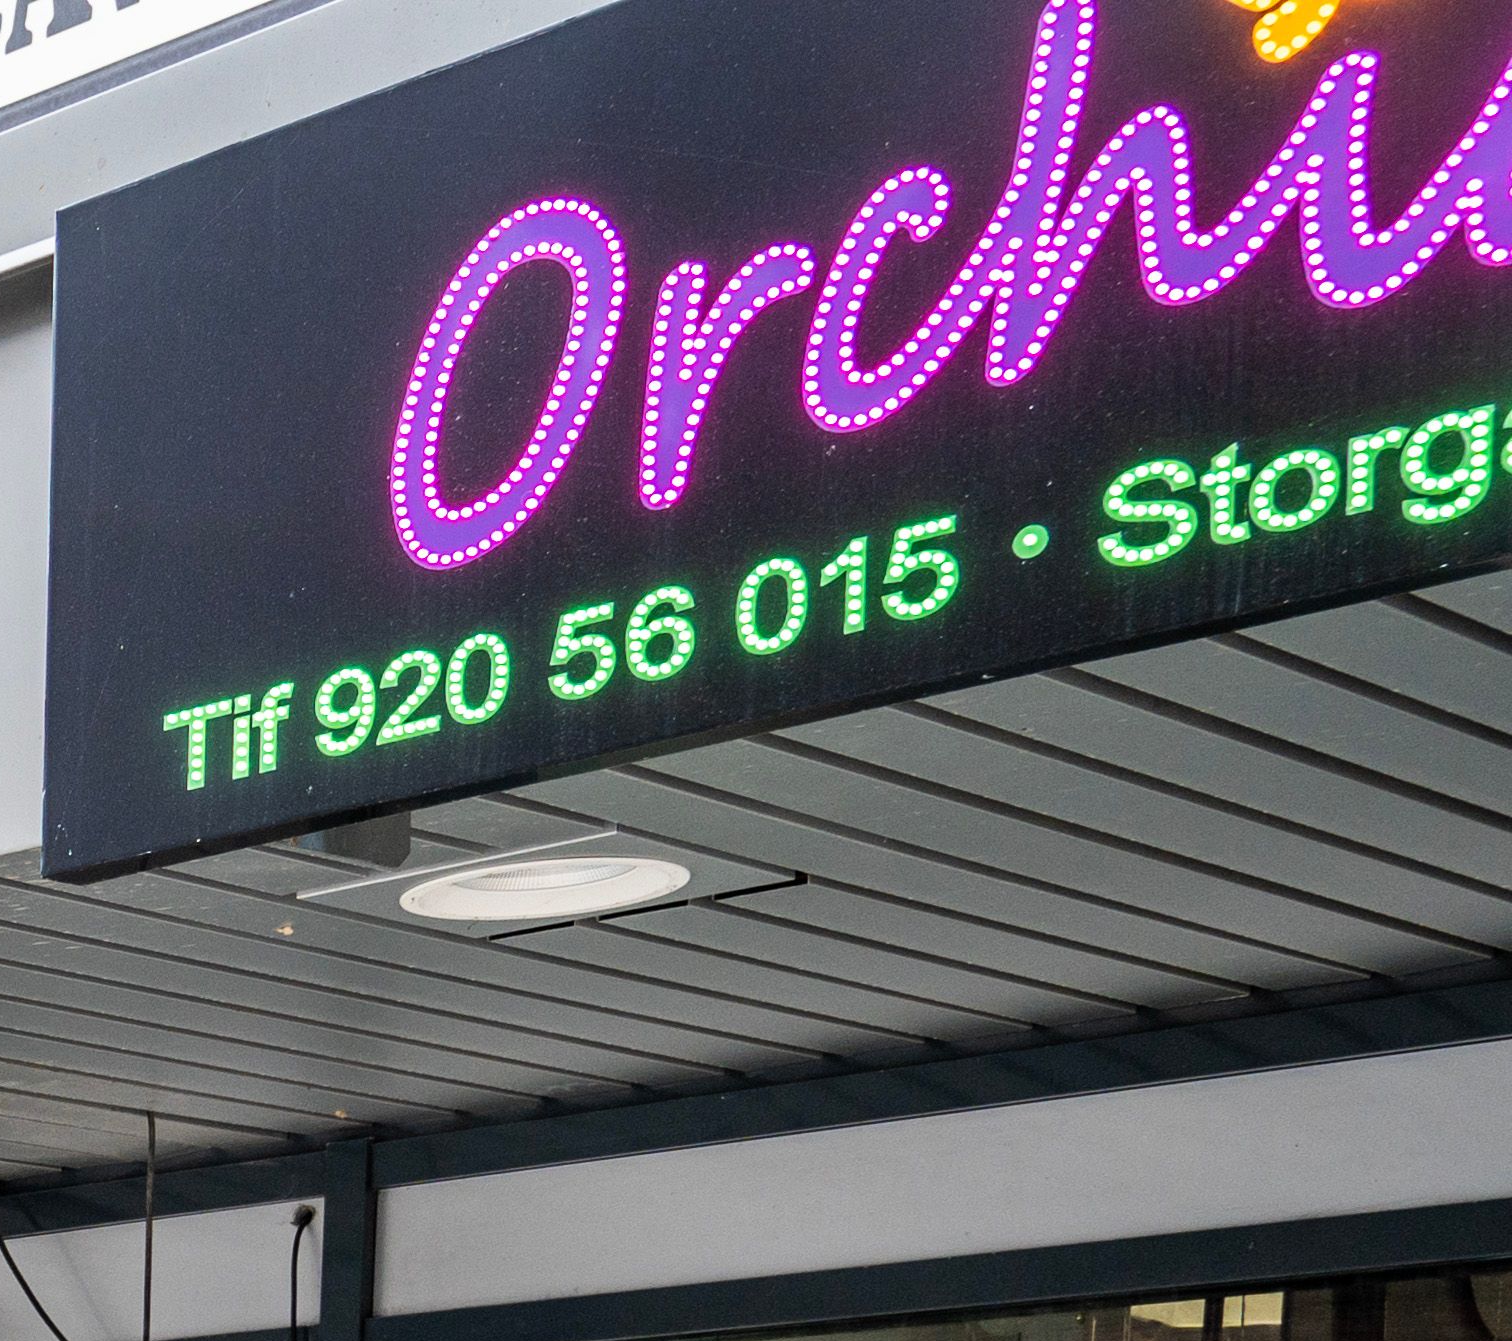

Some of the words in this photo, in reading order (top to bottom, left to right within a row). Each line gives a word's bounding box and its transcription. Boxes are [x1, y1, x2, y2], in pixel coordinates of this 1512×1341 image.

[314, 633, 510, 756] 920
[548, 586, 694, 701] 56
[735, 516, 958, 656] 015
[1097, 403, 1512, 567] Storg
